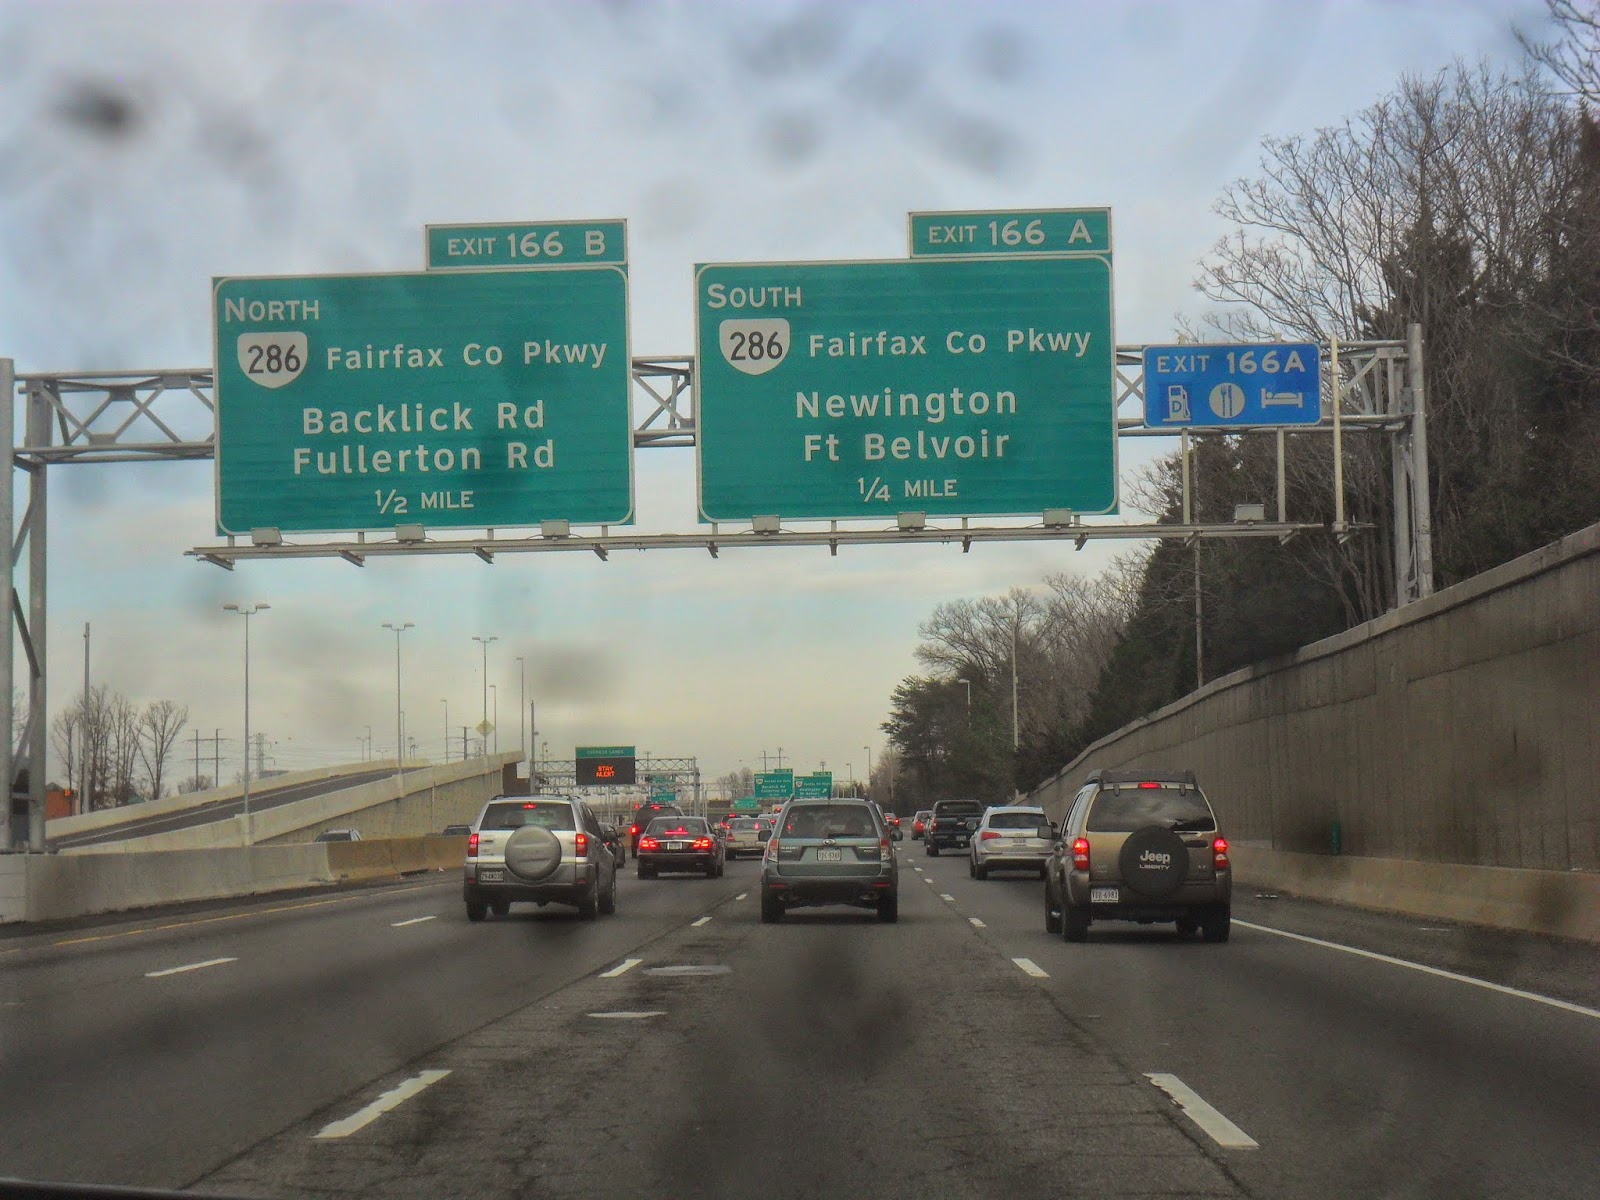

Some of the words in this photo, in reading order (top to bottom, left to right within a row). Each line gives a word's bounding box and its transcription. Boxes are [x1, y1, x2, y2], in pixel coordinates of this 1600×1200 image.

[447, 237, 496, 256] EXIT
[507, 231, 564, 258] 166
[585, 230, 606, 256] B
[928, 225, 977, 244] EXIT
[988, 219, 1046, 246] 166
[1067, 219, 1093, 244] A
[224, 297, 320, 323] NORTH
[706, 283, 802, 310] SOUTH
[326, 343, 444, 371] Fairfax
[462, 343, 503, 367] Co
[523, 339, 608, 370] Pkwy
[729, 331, 783, 361] 286
[808, 331, 927, 358] Fairfax
[945, 330, 986, 354] Co
[1007, 327, 1092, 358] Pkwy
[247, 344, 301, 374] 286
[1156, 354, 1210, 374] EXIT
[1226, 350, 1306, 375] 166A
[302, 402, 474, 435] Backlick
[497, 399, 545, 430] Rd
[795, 386, 1018, 424] Newington
[293, 444, 482, 475] Fullerton
[506, 439, 555, 469] Rd
[804, 433, 841, 462] Ft
[864, 428, 1010, 461] Belvoir
[420, 491, 475, 510] MILE
[904, 479, 959, 498] MILE
[1140, 849, 1171, 864] Jeep
